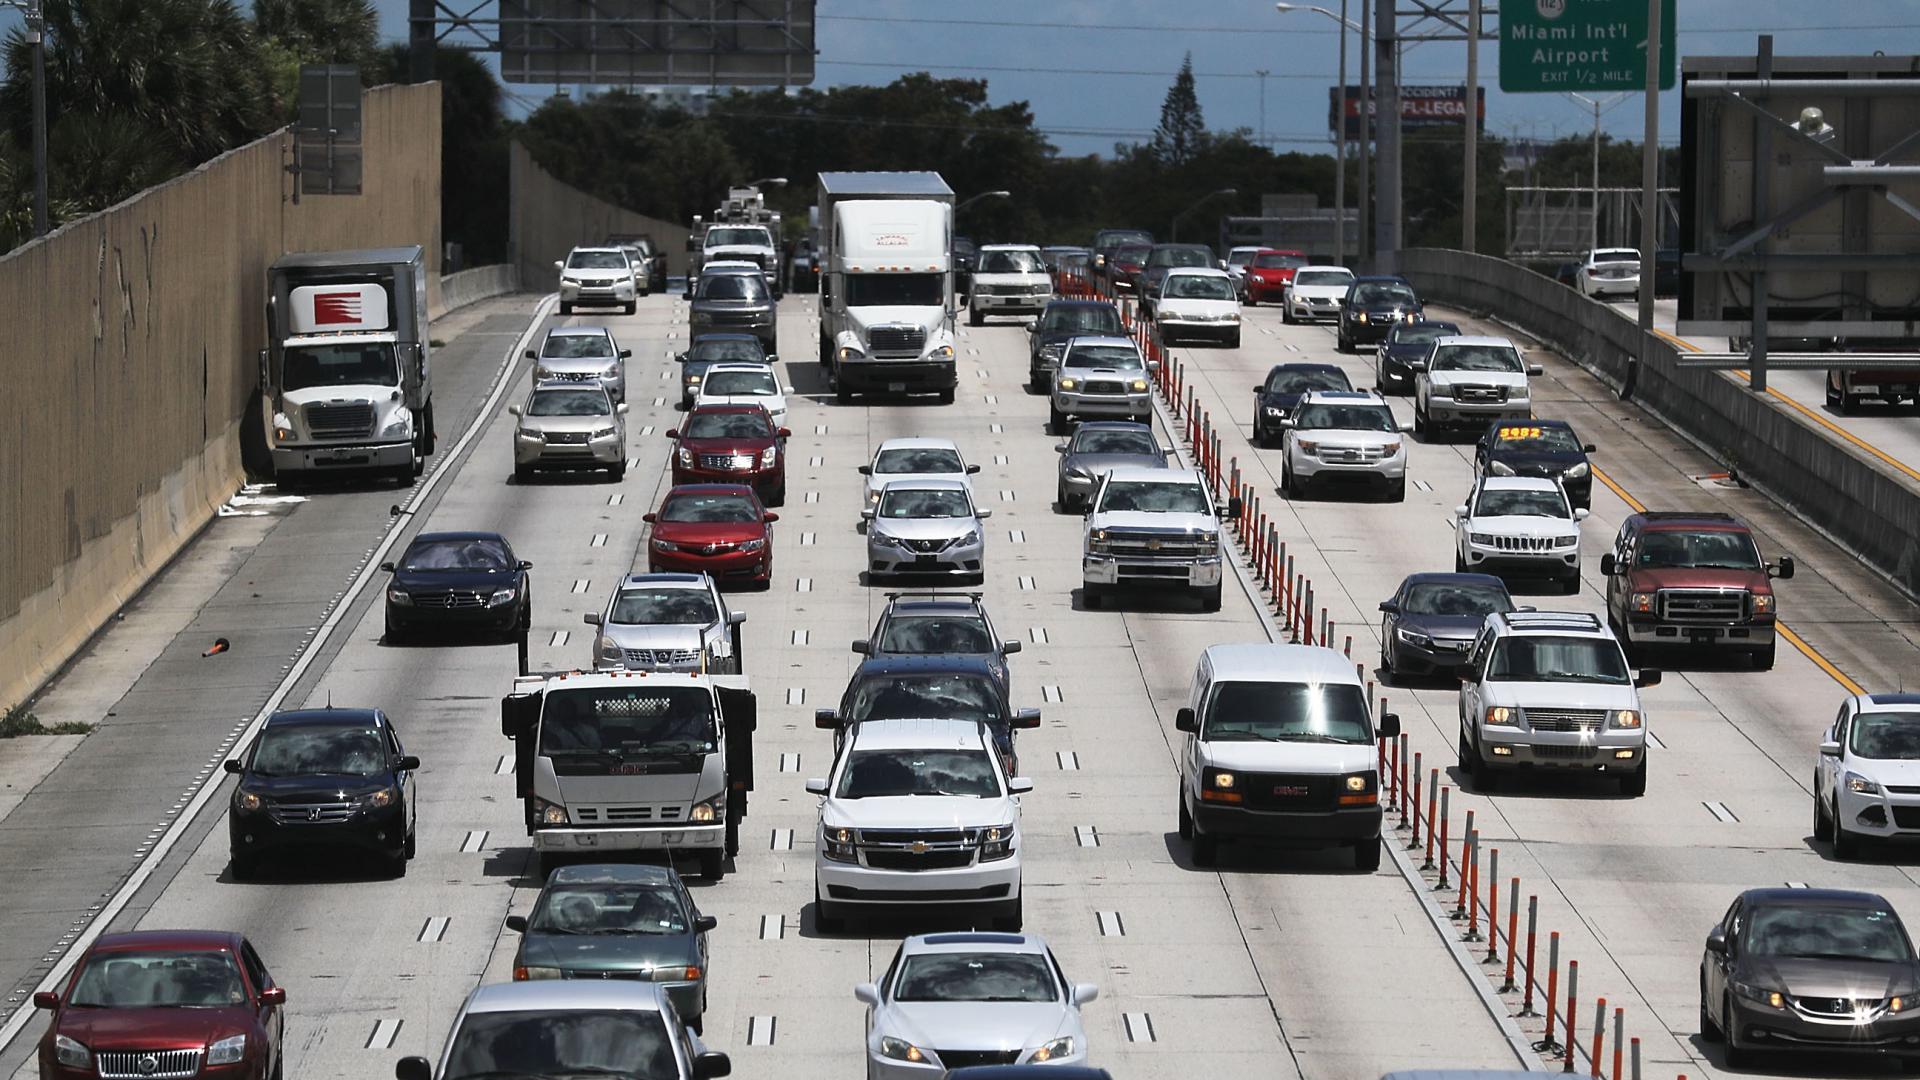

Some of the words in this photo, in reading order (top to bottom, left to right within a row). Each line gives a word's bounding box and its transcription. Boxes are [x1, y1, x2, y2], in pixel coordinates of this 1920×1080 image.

[1512, 24, 1576, 39] Miami
[1587, 23, 1628, 38] Int'l
[1532, 48, 1609, 65] Airport
[1541, 71, 1568, 82] EXIT
[1603, 71, 1632, 81] MILE
[1403, 101, 1467, 115] FL-LEGA
